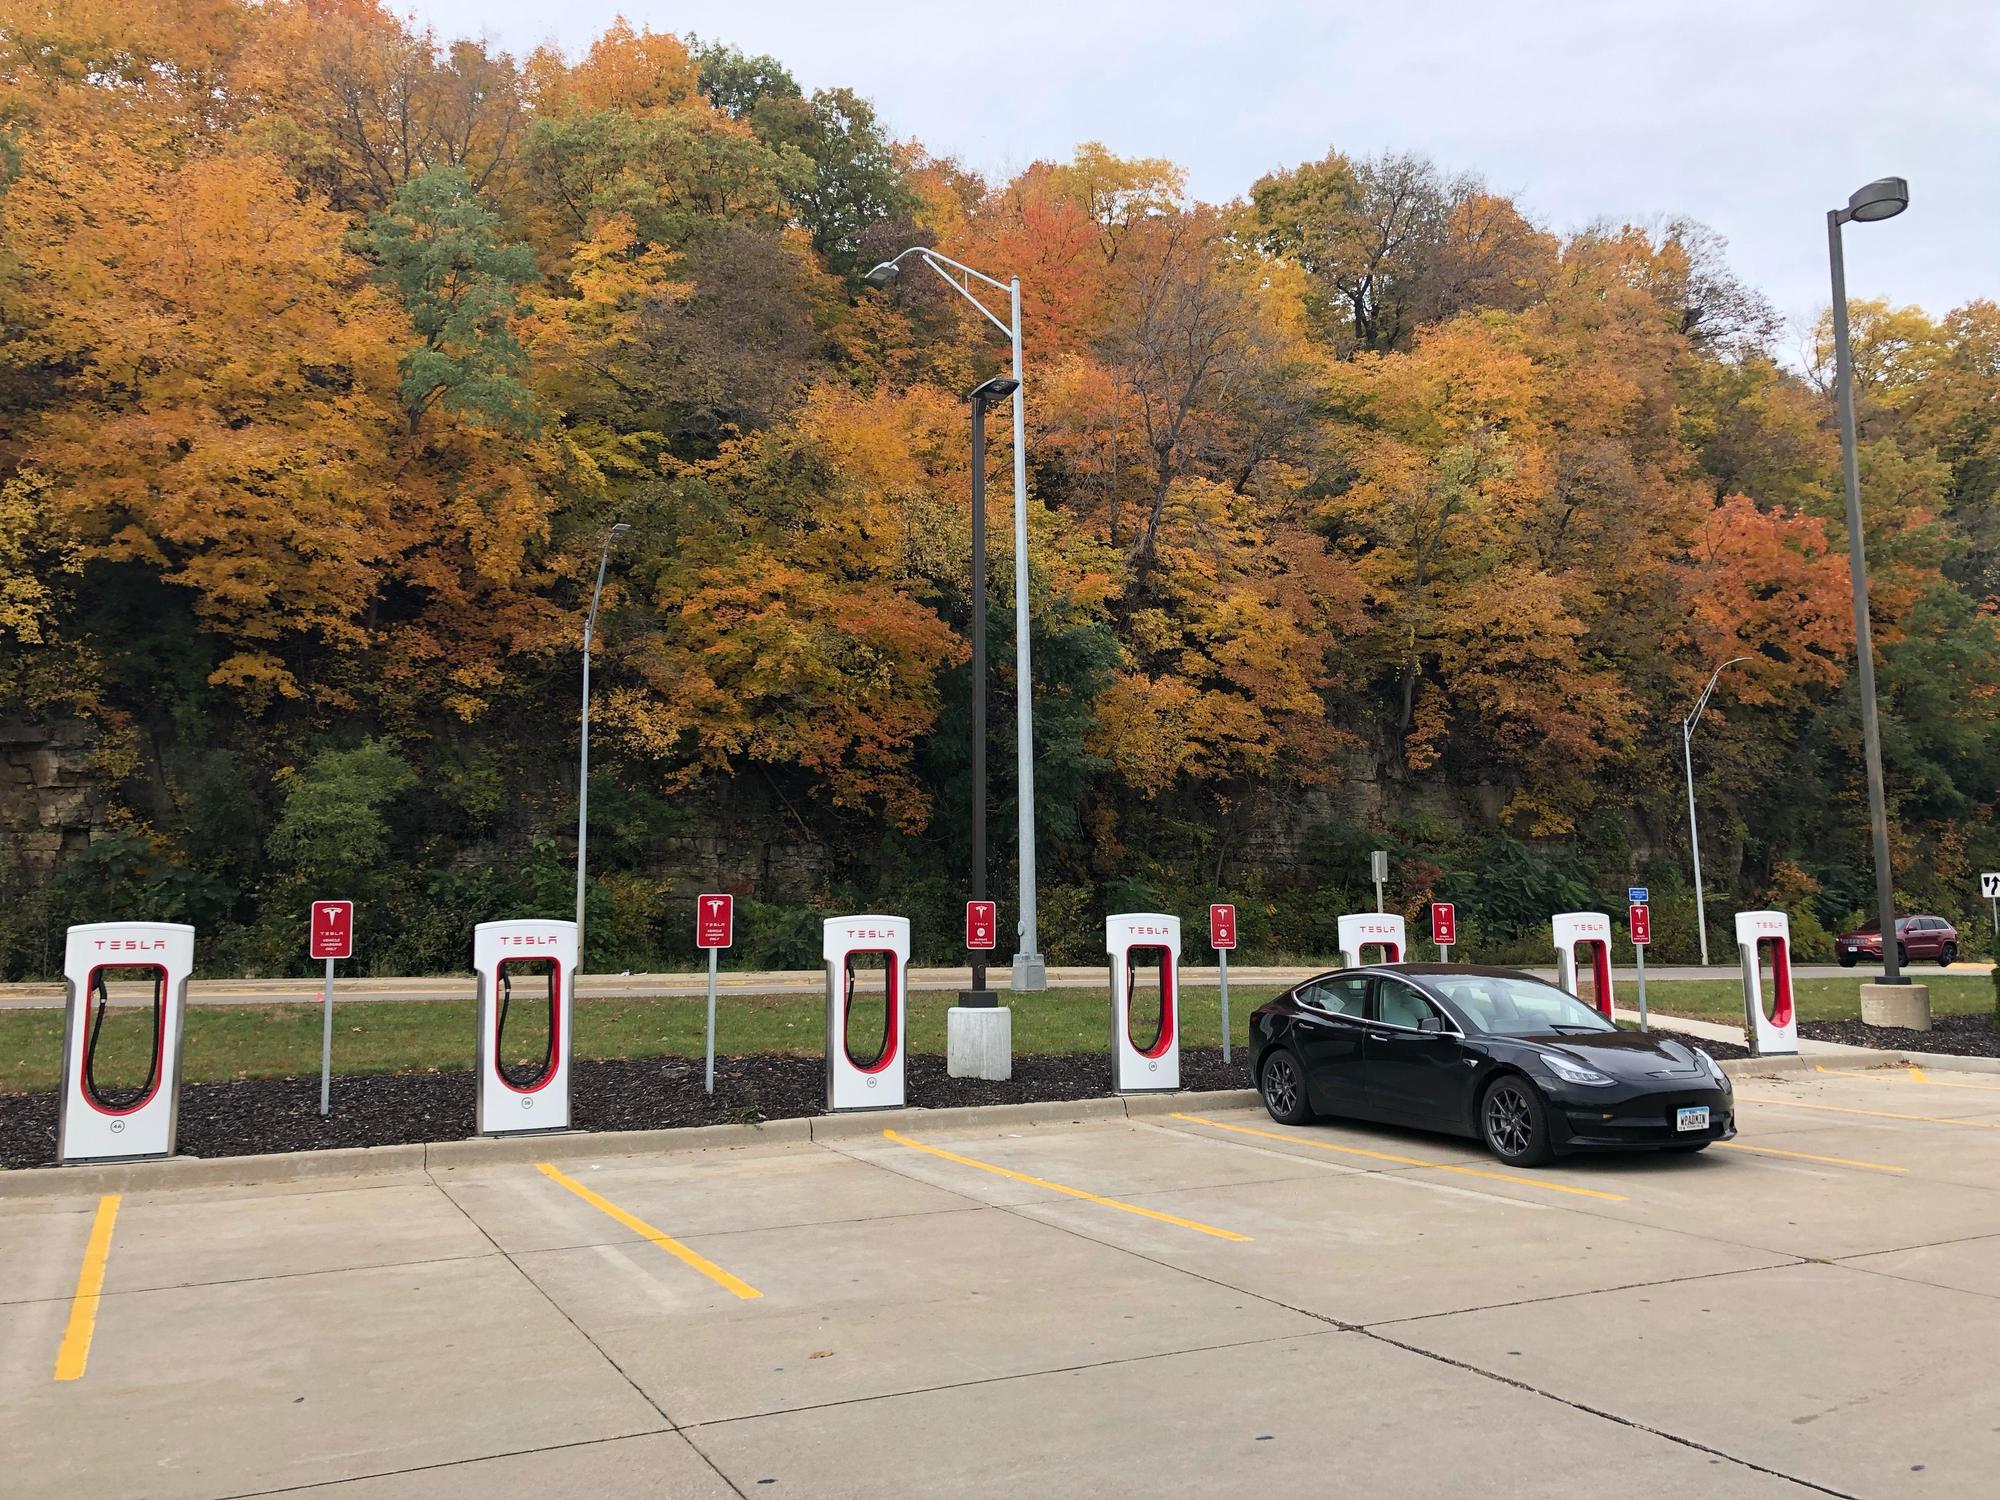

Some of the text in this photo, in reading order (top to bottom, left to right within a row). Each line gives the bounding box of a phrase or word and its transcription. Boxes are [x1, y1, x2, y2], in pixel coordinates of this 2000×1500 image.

[847, 930, 895, 938] TESLA
[1128, 926, 1169, 935] TESLA
[94, 940, 165, 950] TESLA
[500, 936, 558, 945] TESLA
[1680, 1113, 1706, 1126] WPADMIN
